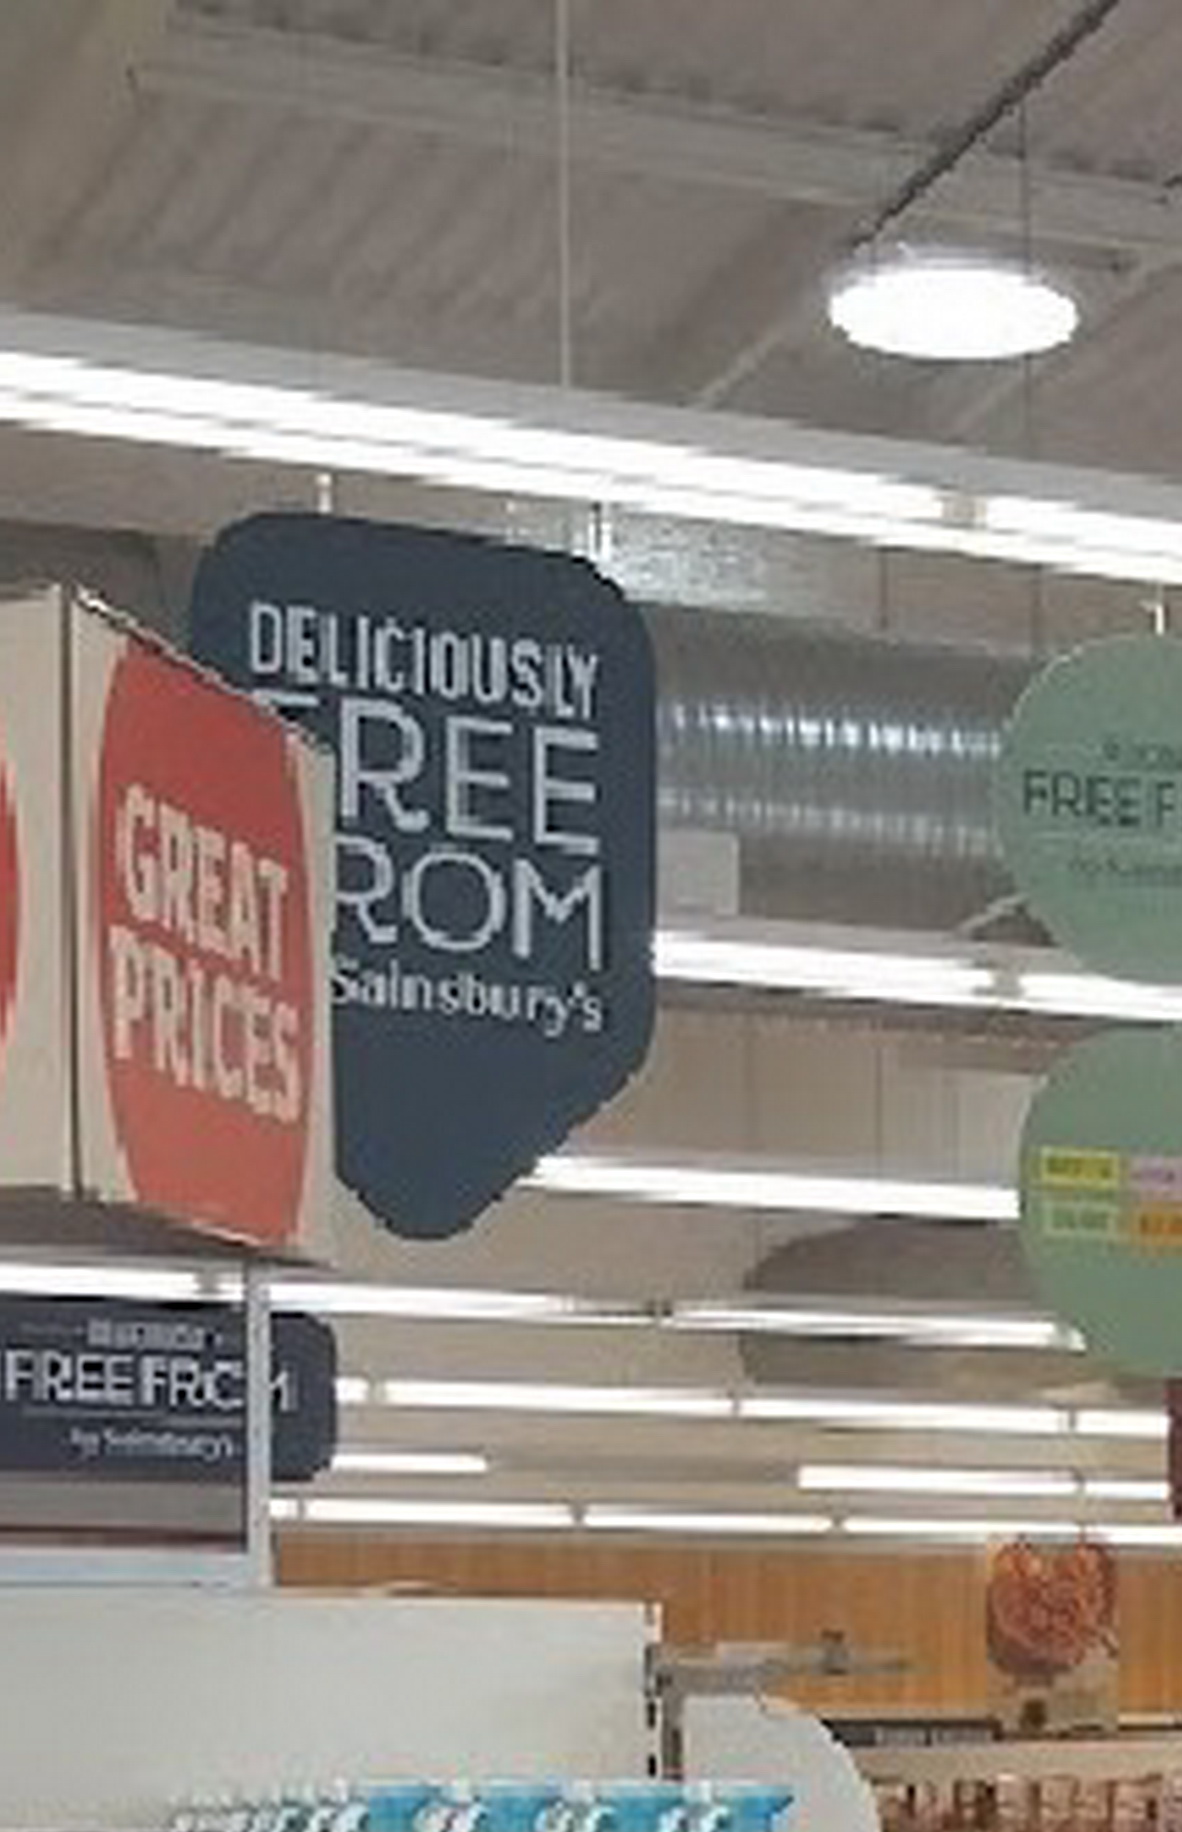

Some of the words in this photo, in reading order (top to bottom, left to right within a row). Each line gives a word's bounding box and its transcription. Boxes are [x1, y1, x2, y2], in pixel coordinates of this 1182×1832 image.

[249, 601, 599, 718] DELICIOUSLY
[252, 687, 600, 856] REE
[1022, 768, 1142, 828] FREE
[116, 784, 288, 984] GREAT
[334, 833, 601, 971] ROM
[109, 924, 300, 1123] PRICES
[5, 1348, 134, 1406] FREE
